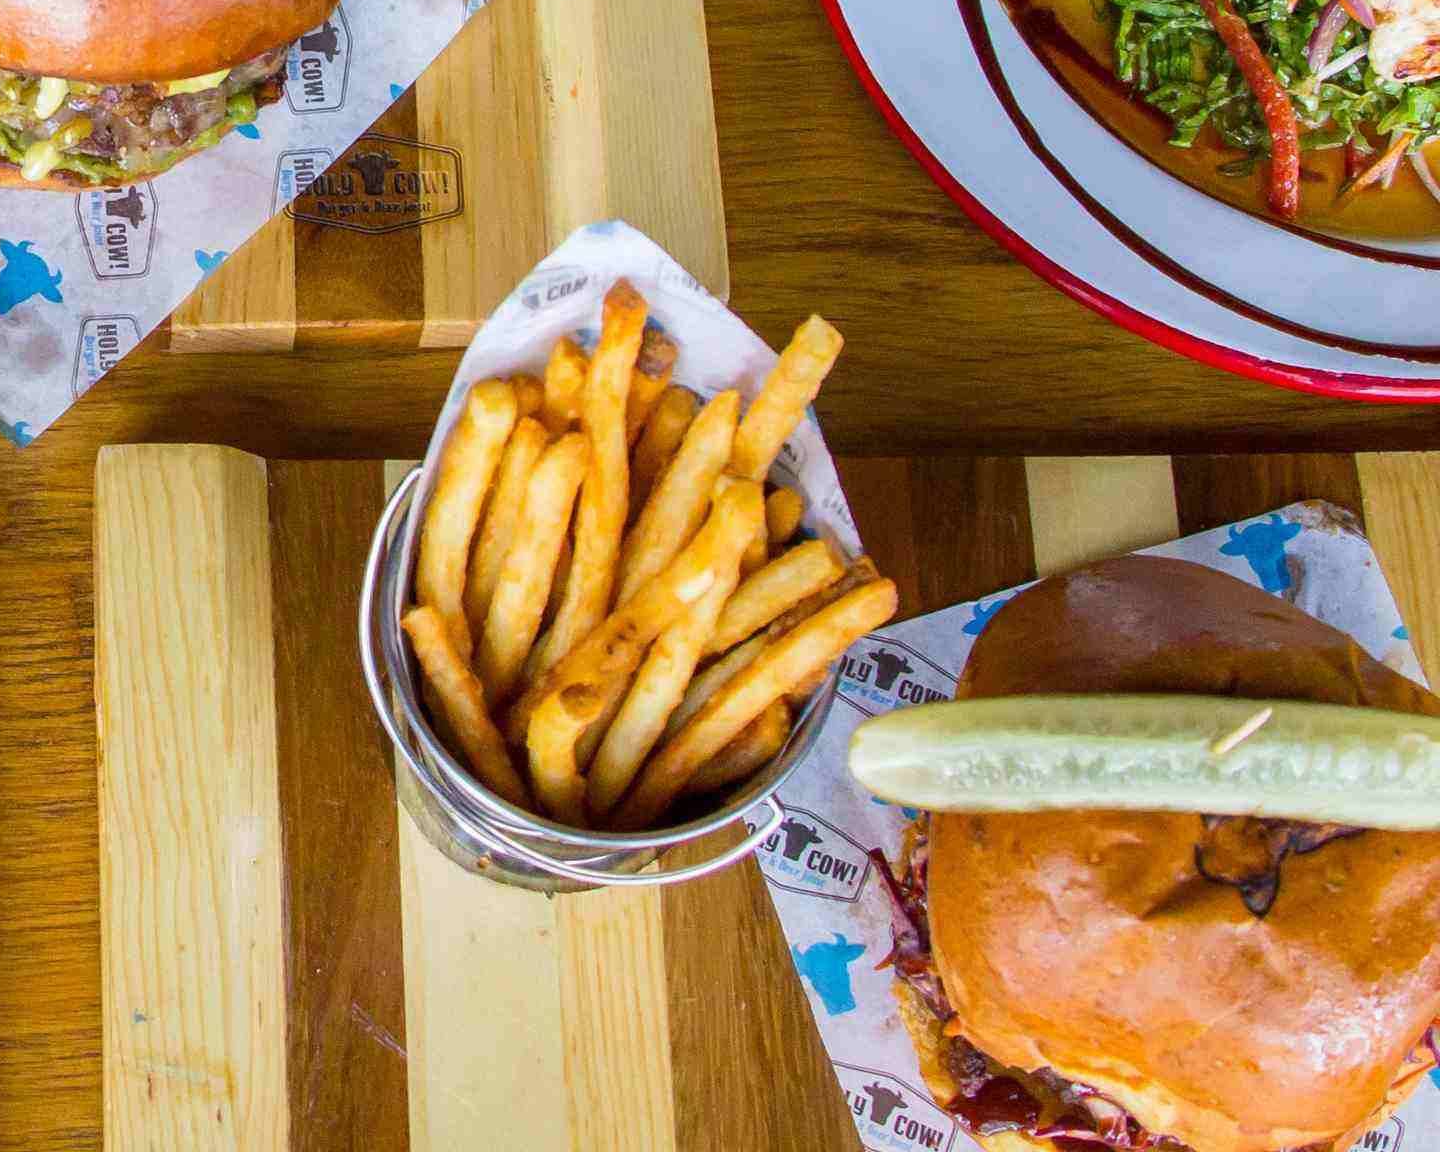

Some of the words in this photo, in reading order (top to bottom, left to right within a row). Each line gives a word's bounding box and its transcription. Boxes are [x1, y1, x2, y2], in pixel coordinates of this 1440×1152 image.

[301, 58, 325, 104] COW!
[393, 170, 449, 195] COW!
[106, 223, 130, 269] COW!
[806, 850, 858, 886] COW!
[893, 1114, 944, 1152] COW!
